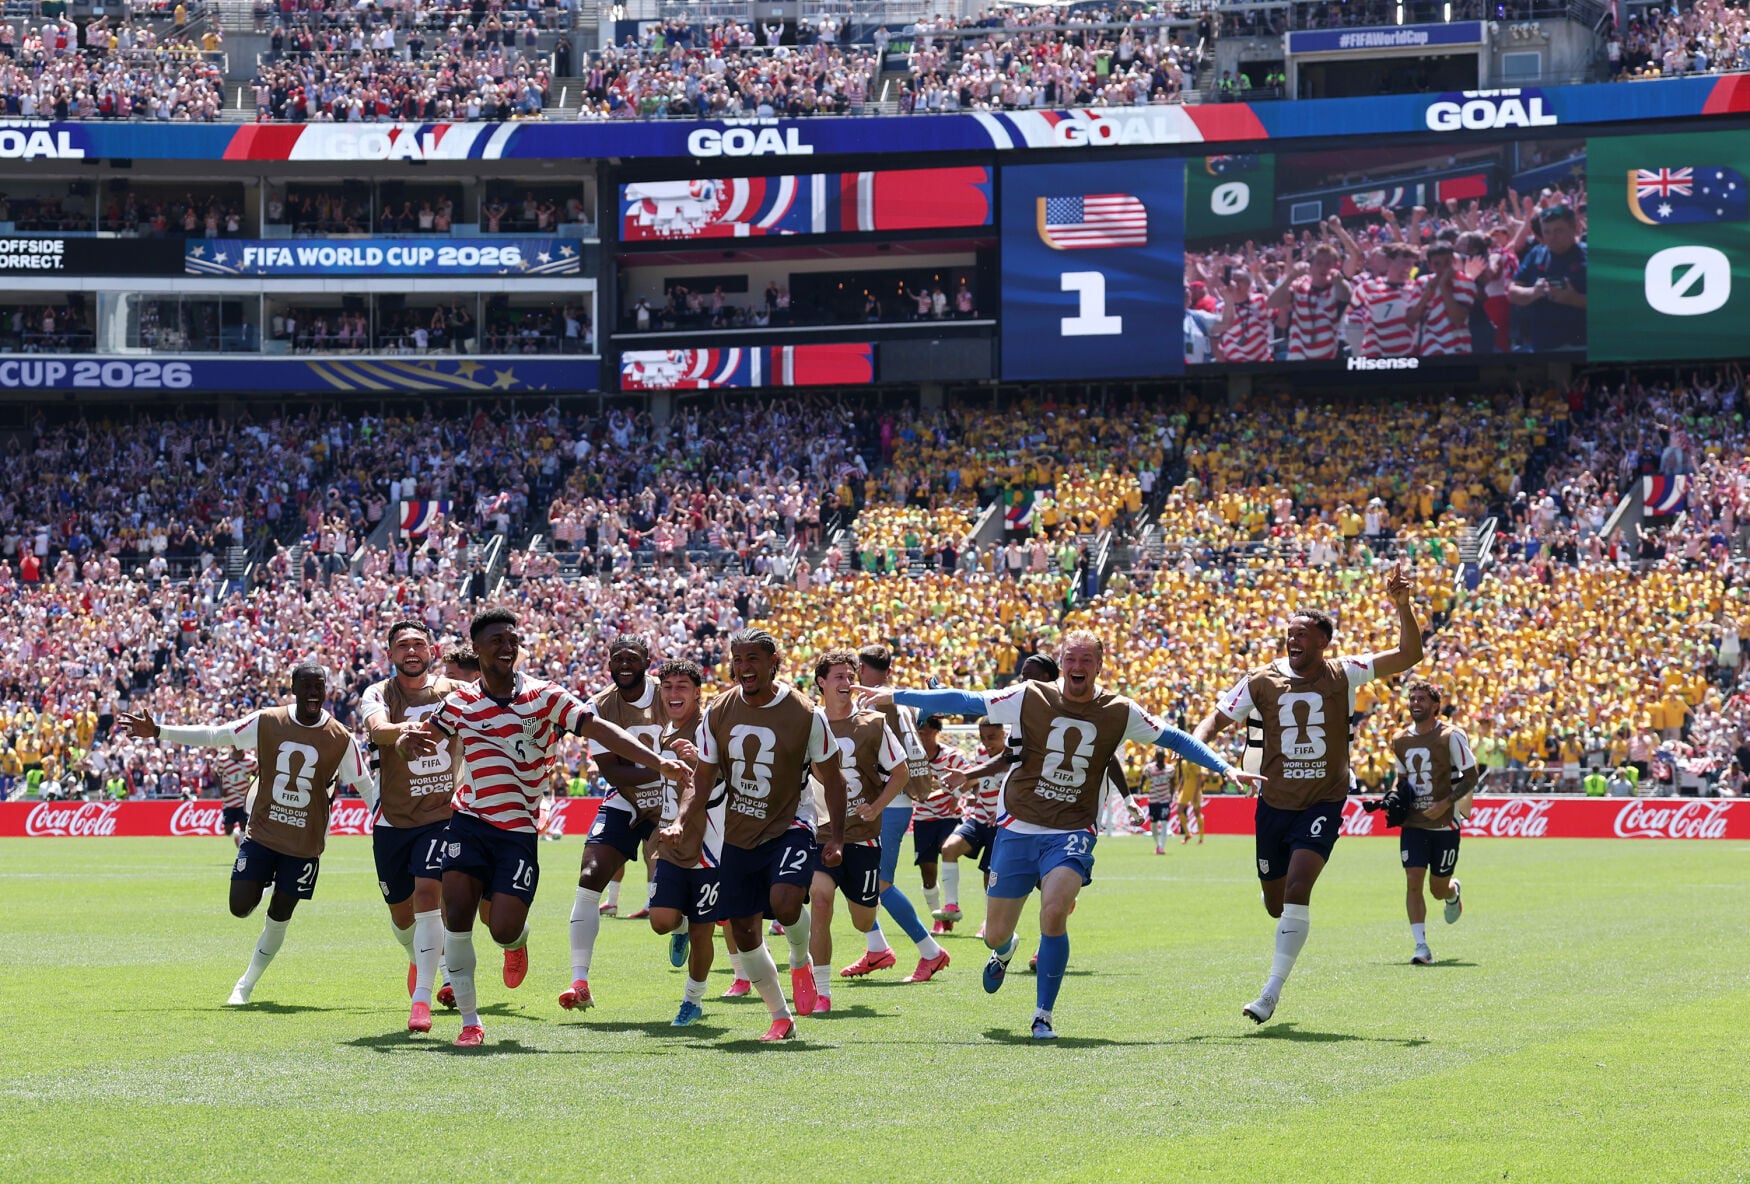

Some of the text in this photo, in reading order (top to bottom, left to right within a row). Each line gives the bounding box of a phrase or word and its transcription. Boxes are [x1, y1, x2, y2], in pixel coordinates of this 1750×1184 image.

[1339, 31, 1429, 48] #FIFAWorldCup
[1426, 97, 1557, 131] GOAL
[1054, 116, 1180, 147] GOAL
[0, 130, 85, 158] OAL
[325, 132, 448, 159] GOAL
[688, 127, 814, 157] GOAL
[1211, 181, 1250, 215] 0
[0, 239, 64, 253] OFFSIDE
[0, 255, 64, 268] ORRECT.
[243, 246, 521, 266] FIFA WORLD CUP 2026
[1645, 245, 1731, 316] 0
[1061, 271, 1122, 336] 1
[1347, 357, 1419, 370] Hisense
[0, 361, 193, 388] CUP 2026
[1294, 746, 1315, 755] FIFA
[421, 758, 441, 768] FIFA
[410, 775, 438, 785] WORLD
[1053, 771, 1074, 782] FIFA
[1283, 768, 1326, 778] 2026
[410, 781, 453, 797] 2026
[741, 781, 759, 791] FIFA
[1034, 786, 1077, 803] 2026
[281, 792, 299, 802] FIFA
[753, 800, 768, 808] CUP
[25, 801, 121, 836] Coca-Cola
[269, 810, 307, 828] 2026
[270, 804, 307, 818] WORLD CUP
[730, 800, 767, 819] 2026
[1461, 799, 1554, 837] ca-Cola
[1614, 800, 1734, 838] Coca-Cola
[1310, 815, 1327, 835] 6
[1064, 834, 1090, 853] 25
[779, 846, 808, 870] 12
[1440, 848, 1456, 867] 10
[296, 863, 318, 885] 21
[512, 859, 534, 887] 16
[862, 869, 878, 893] 11
[696, 881, 720, 908] 26
